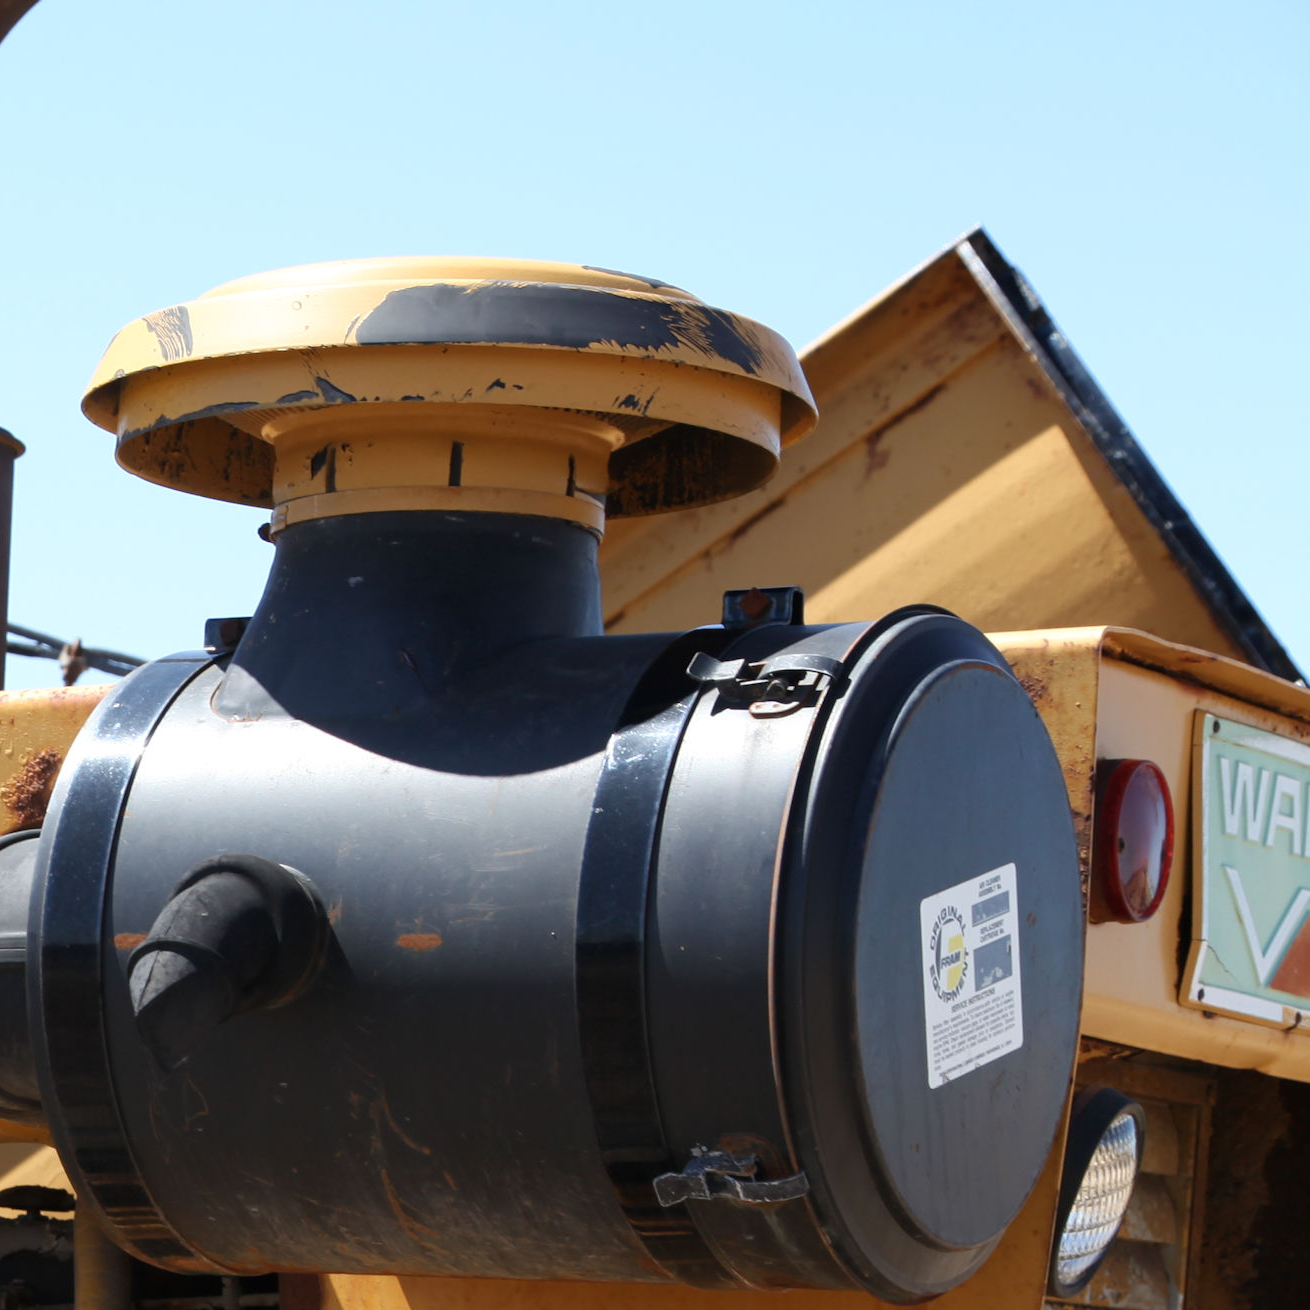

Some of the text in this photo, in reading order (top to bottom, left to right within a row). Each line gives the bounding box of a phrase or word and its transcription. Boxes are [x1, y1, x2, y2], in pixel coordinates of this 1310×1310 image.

[1217, 755, 1310, 860] WA
[930, 905, 967, 951] ORIGINAL
[930, 946, 969, 1004] EQUIPMENT
[941, 950, 961, 969] FRAM
